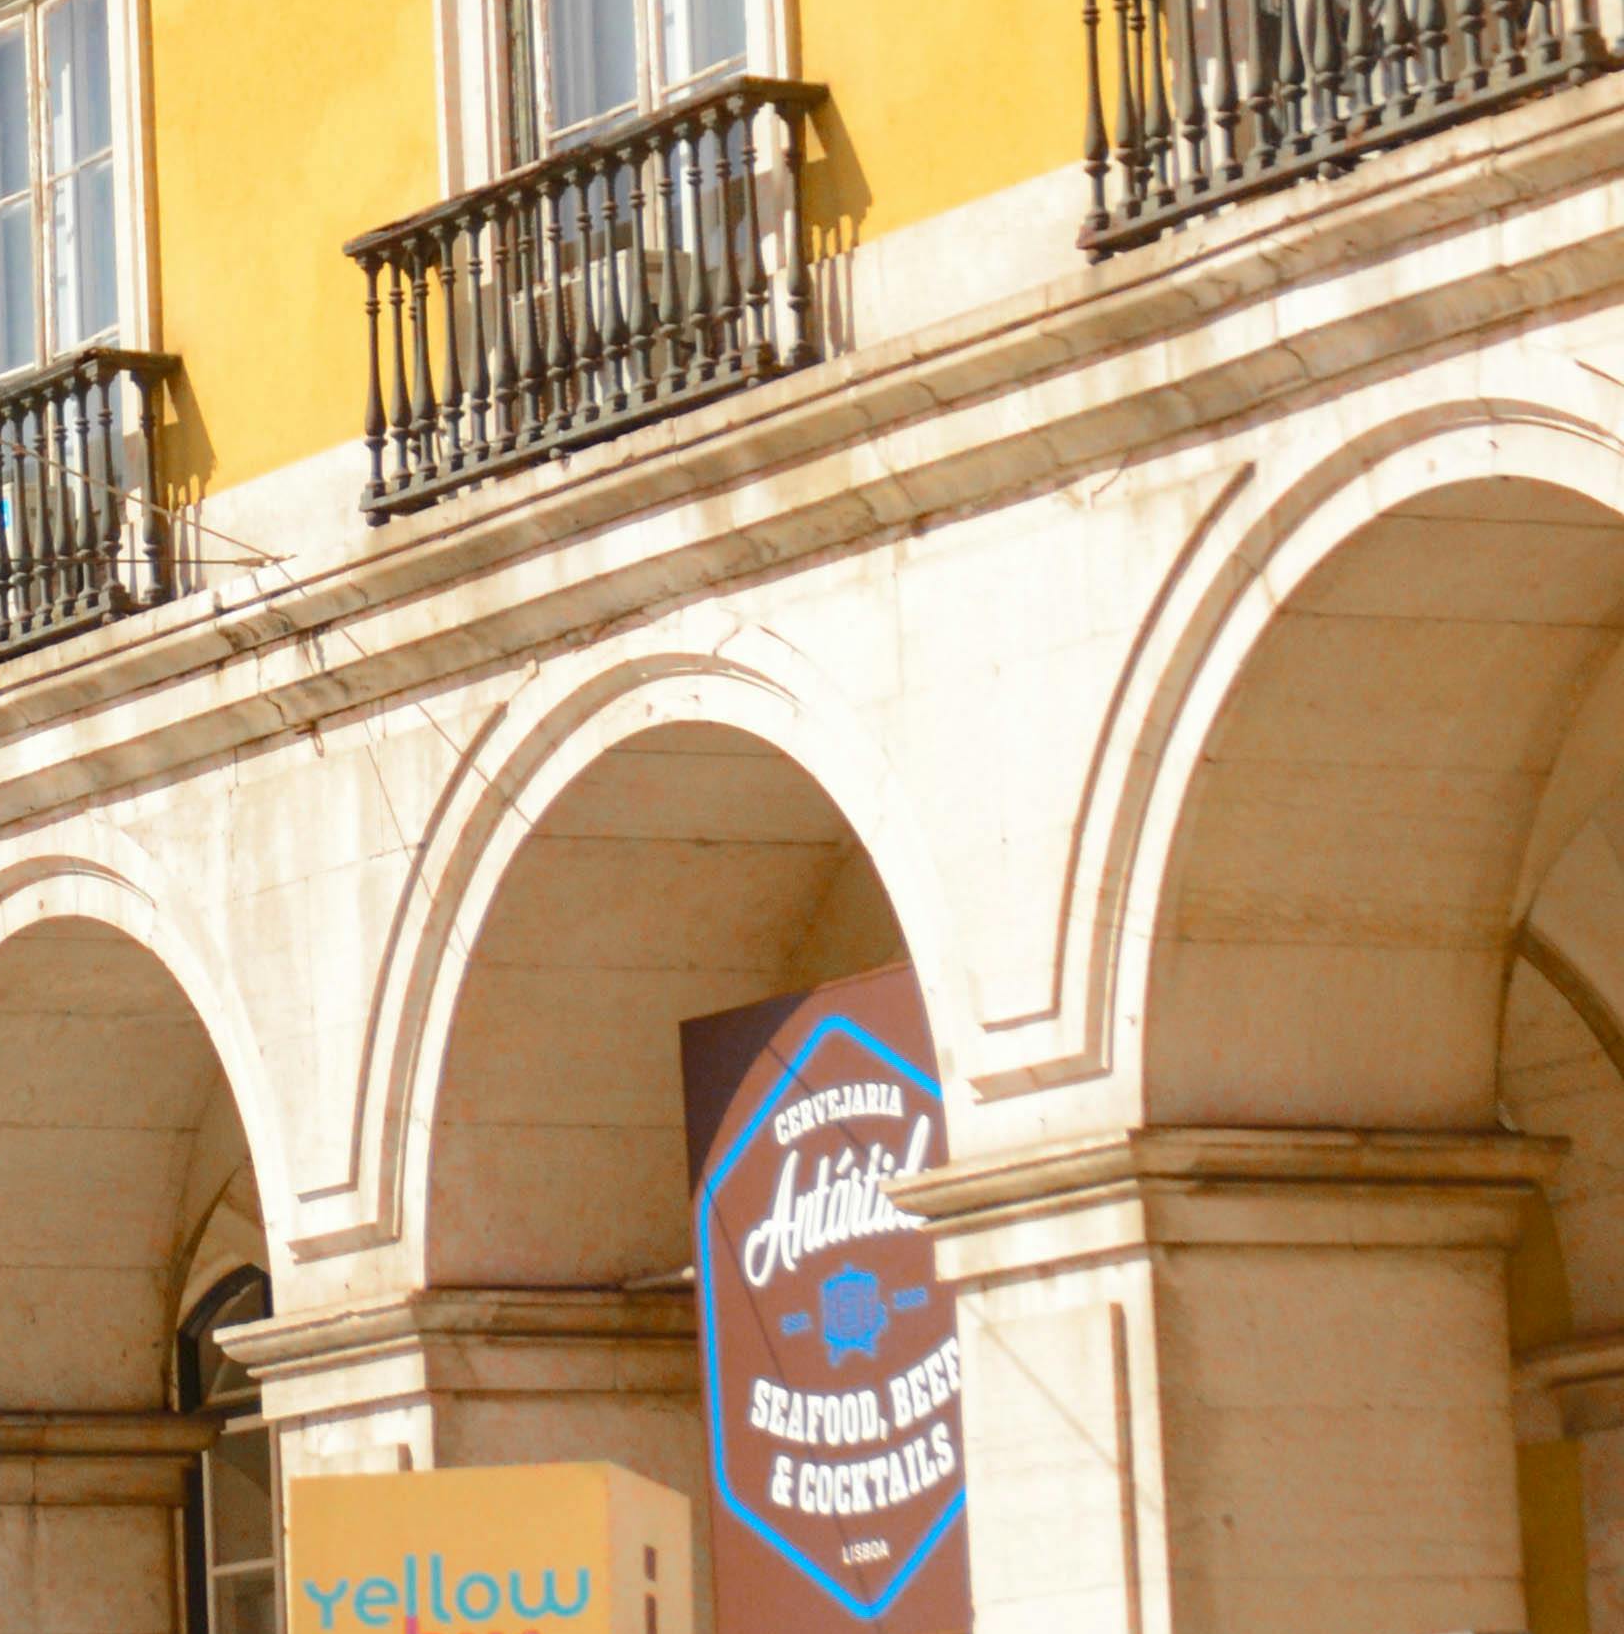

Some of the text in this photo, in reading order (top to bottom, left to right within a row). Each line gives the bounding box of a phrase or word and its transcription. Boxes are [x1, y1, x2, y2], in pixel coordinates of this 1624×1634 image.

[774, 1083, 904, 1146] CERVEJARIA
[744, 1114, 932, 1287] Antártid
[751, 1378, 889, 1446] SEAFOOD,
[771, 1421, 956, 1515] & COCKTAILS
[842, 1537, 890, 1566] LISBOA
[302, 1552, 591, 1630] yellow
